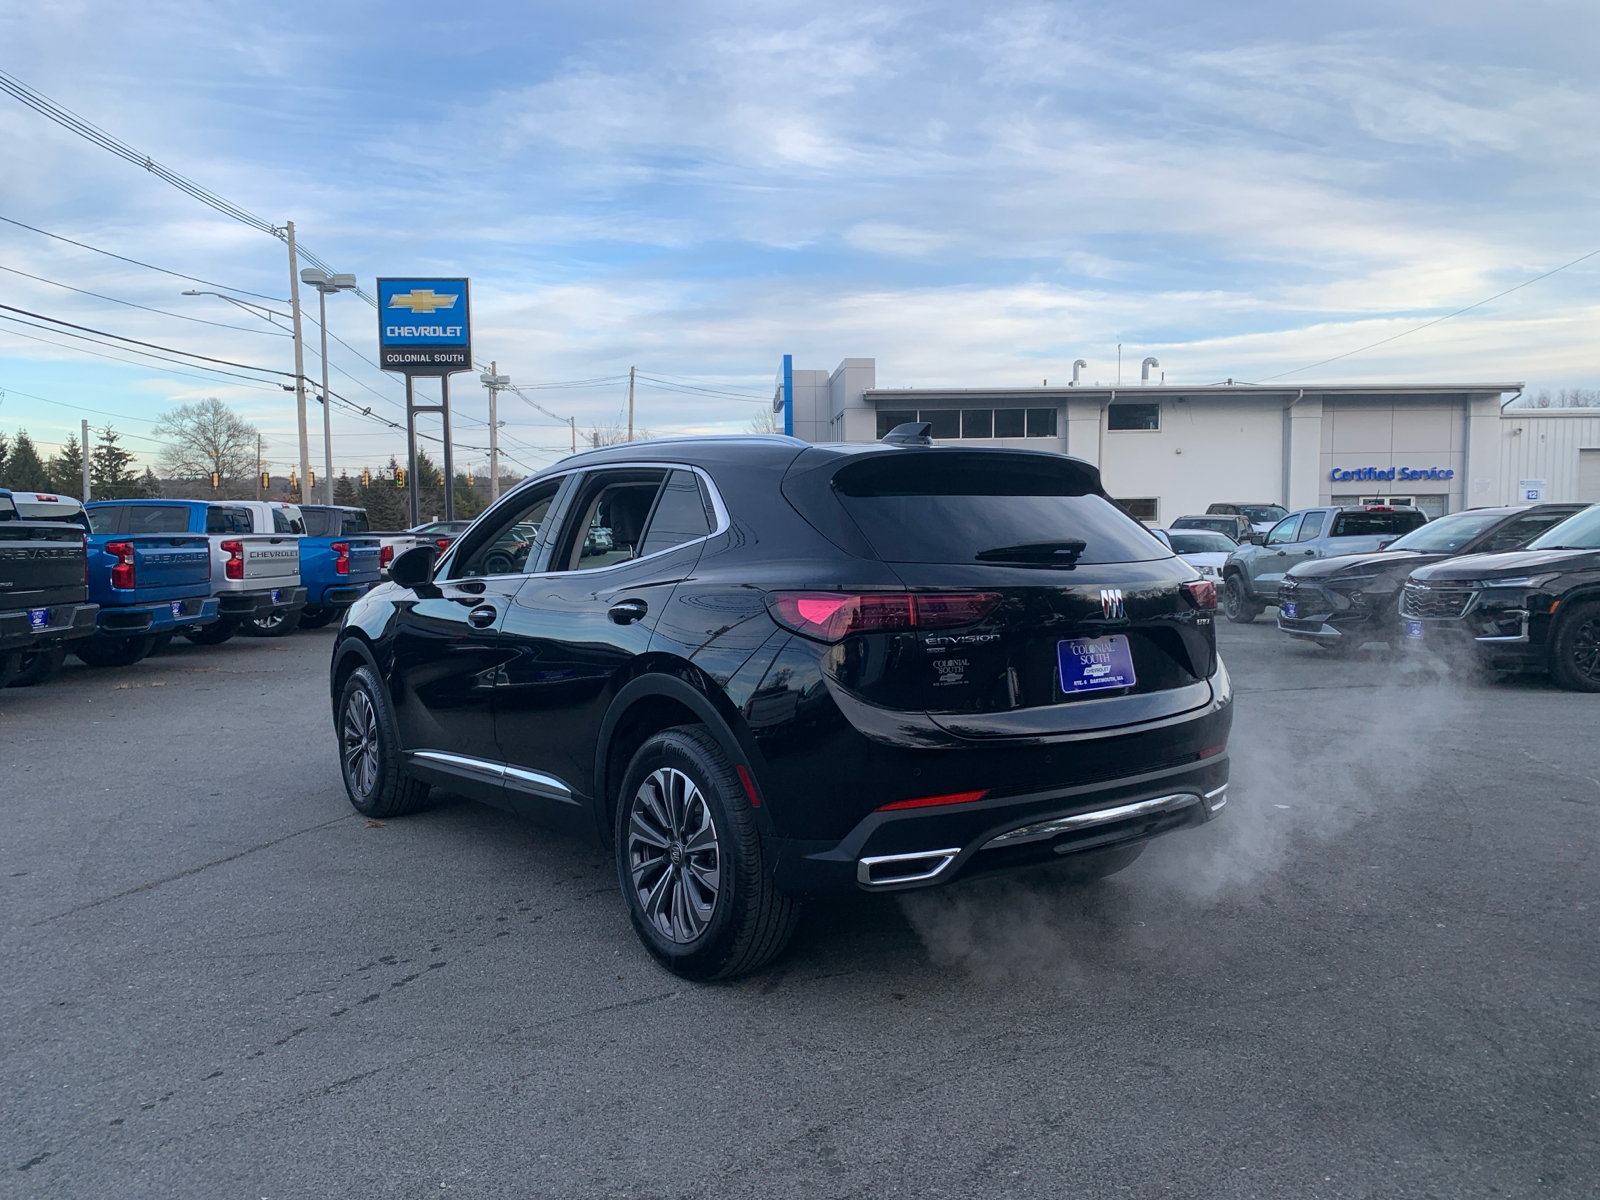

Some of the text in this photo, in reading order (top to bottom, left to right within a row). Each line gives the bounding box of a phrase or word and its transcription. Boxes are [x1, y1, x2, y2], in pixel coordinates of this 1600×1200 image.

[387, 326, 462, 336] CHEVROLET
[386, 354, 464, 362] COLONIAL SOUTH
[1331, 466, 1454, 481] Certified Service
[1528, 491, 1537, 499] 12
[1072, 643, 1115, 656] COLONIAL
[933, 659, 970, 669] COLONIAL
[1080, 653, 1110, 665] SOUTH
[938, 666, 964, 674] SOUTH
